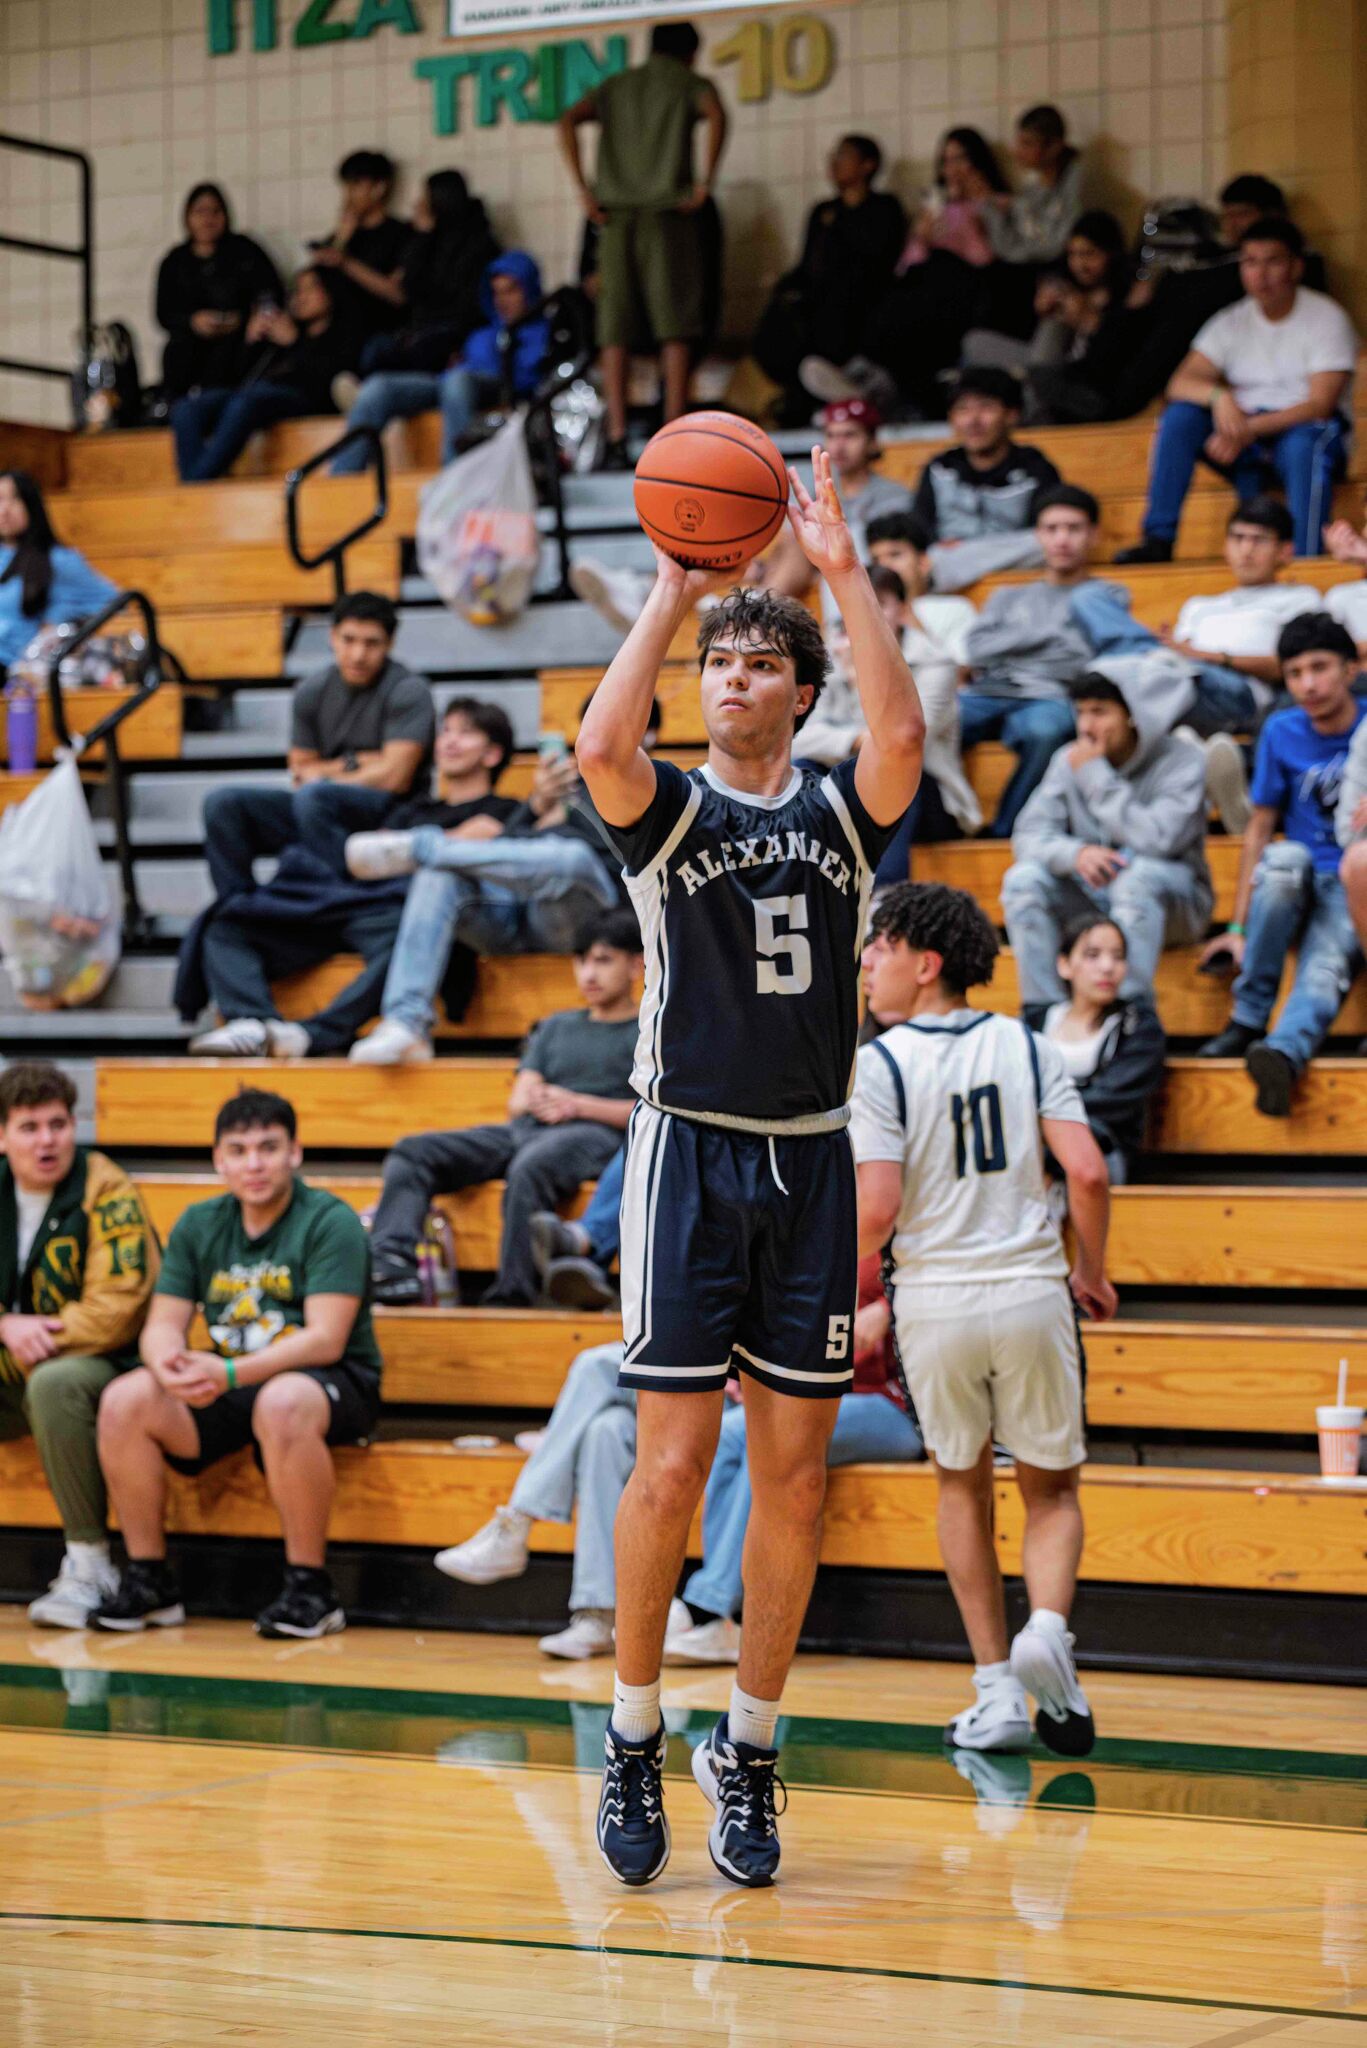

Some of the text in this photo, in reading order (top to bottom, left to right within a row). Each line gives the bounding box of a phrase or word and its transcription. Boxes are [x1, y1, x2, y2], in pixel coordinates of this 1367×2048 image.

[712, 14, 835, 101] 10
[675, 831, 851, 896] ALEXANDER
[752, 894, 812, 995] 5
[951, 1083, 1007, 1180] 10
[825, 1315, 850, 1360] 5
